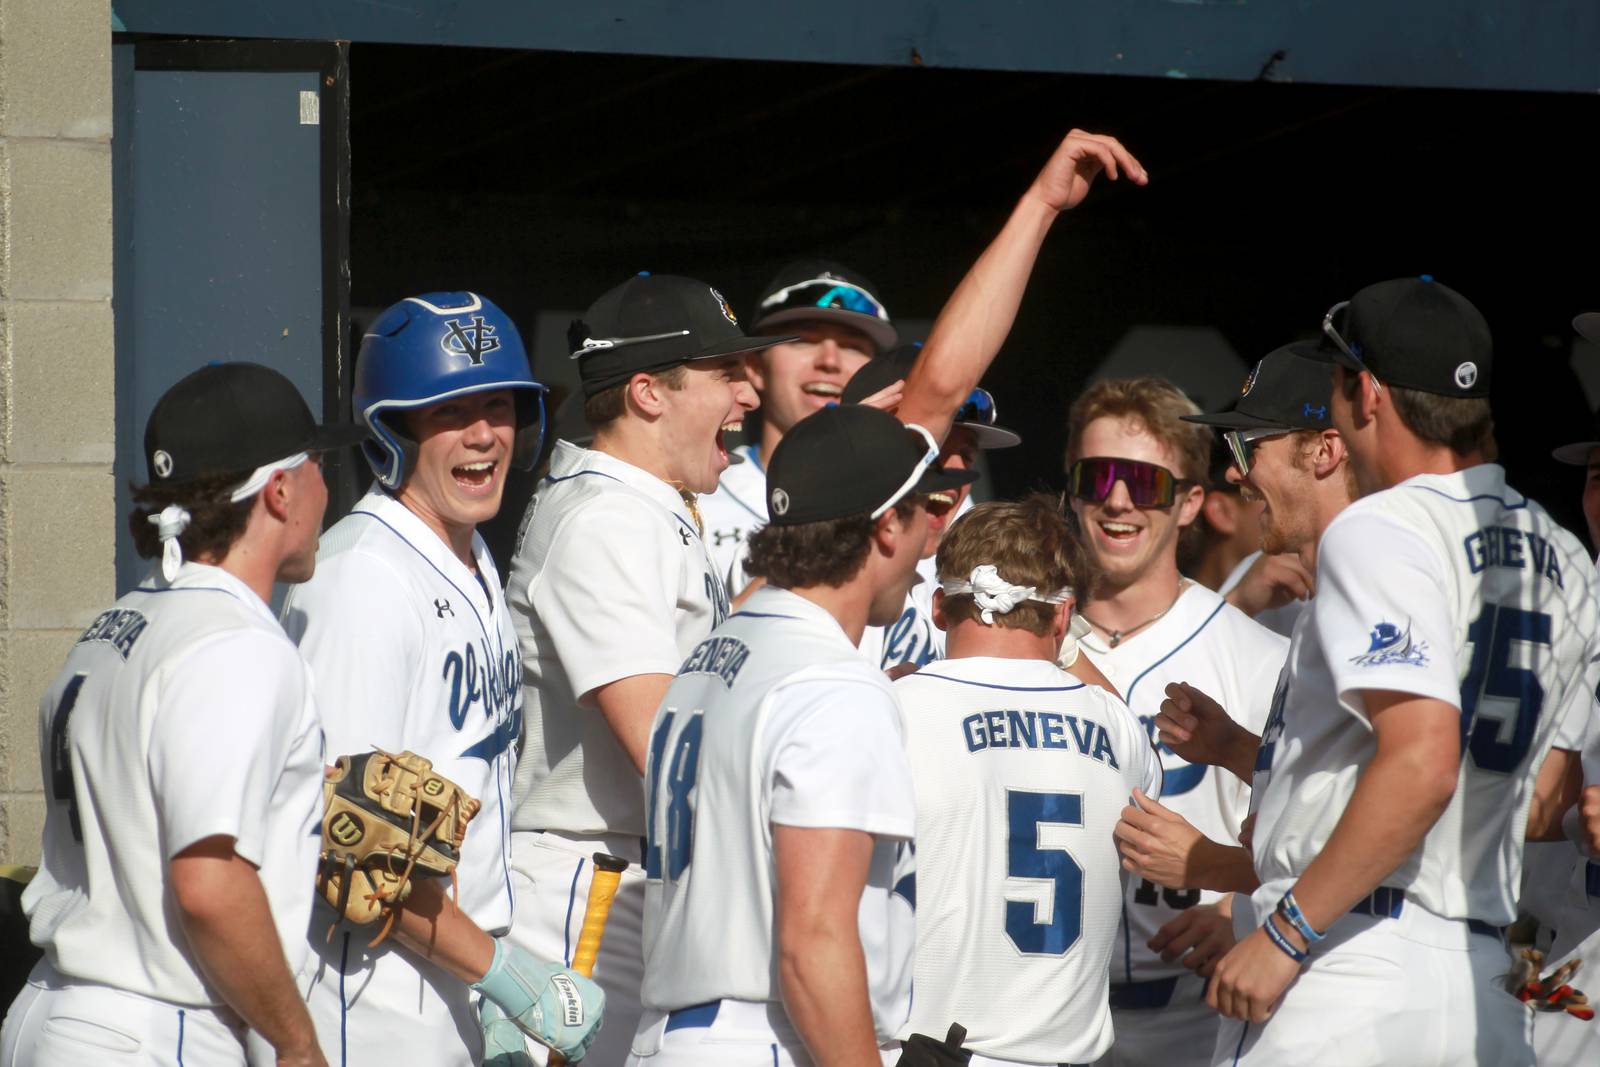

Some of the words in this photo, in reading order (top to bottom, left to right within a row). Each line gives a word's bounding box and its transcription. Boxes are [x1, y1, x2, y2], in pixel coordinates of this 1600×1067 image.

[1464, 526, 1564, 590] GEVA
[79, 609, 147, 661] ENEVA
[678, 636, 750, 690] ENEVA
[1460, 602, 1553, 774] 15
[961, 709, 1121, 773] GENEVA
[645, 709, 703, 882] 18
[1003, 787, 1085, 957] 5
